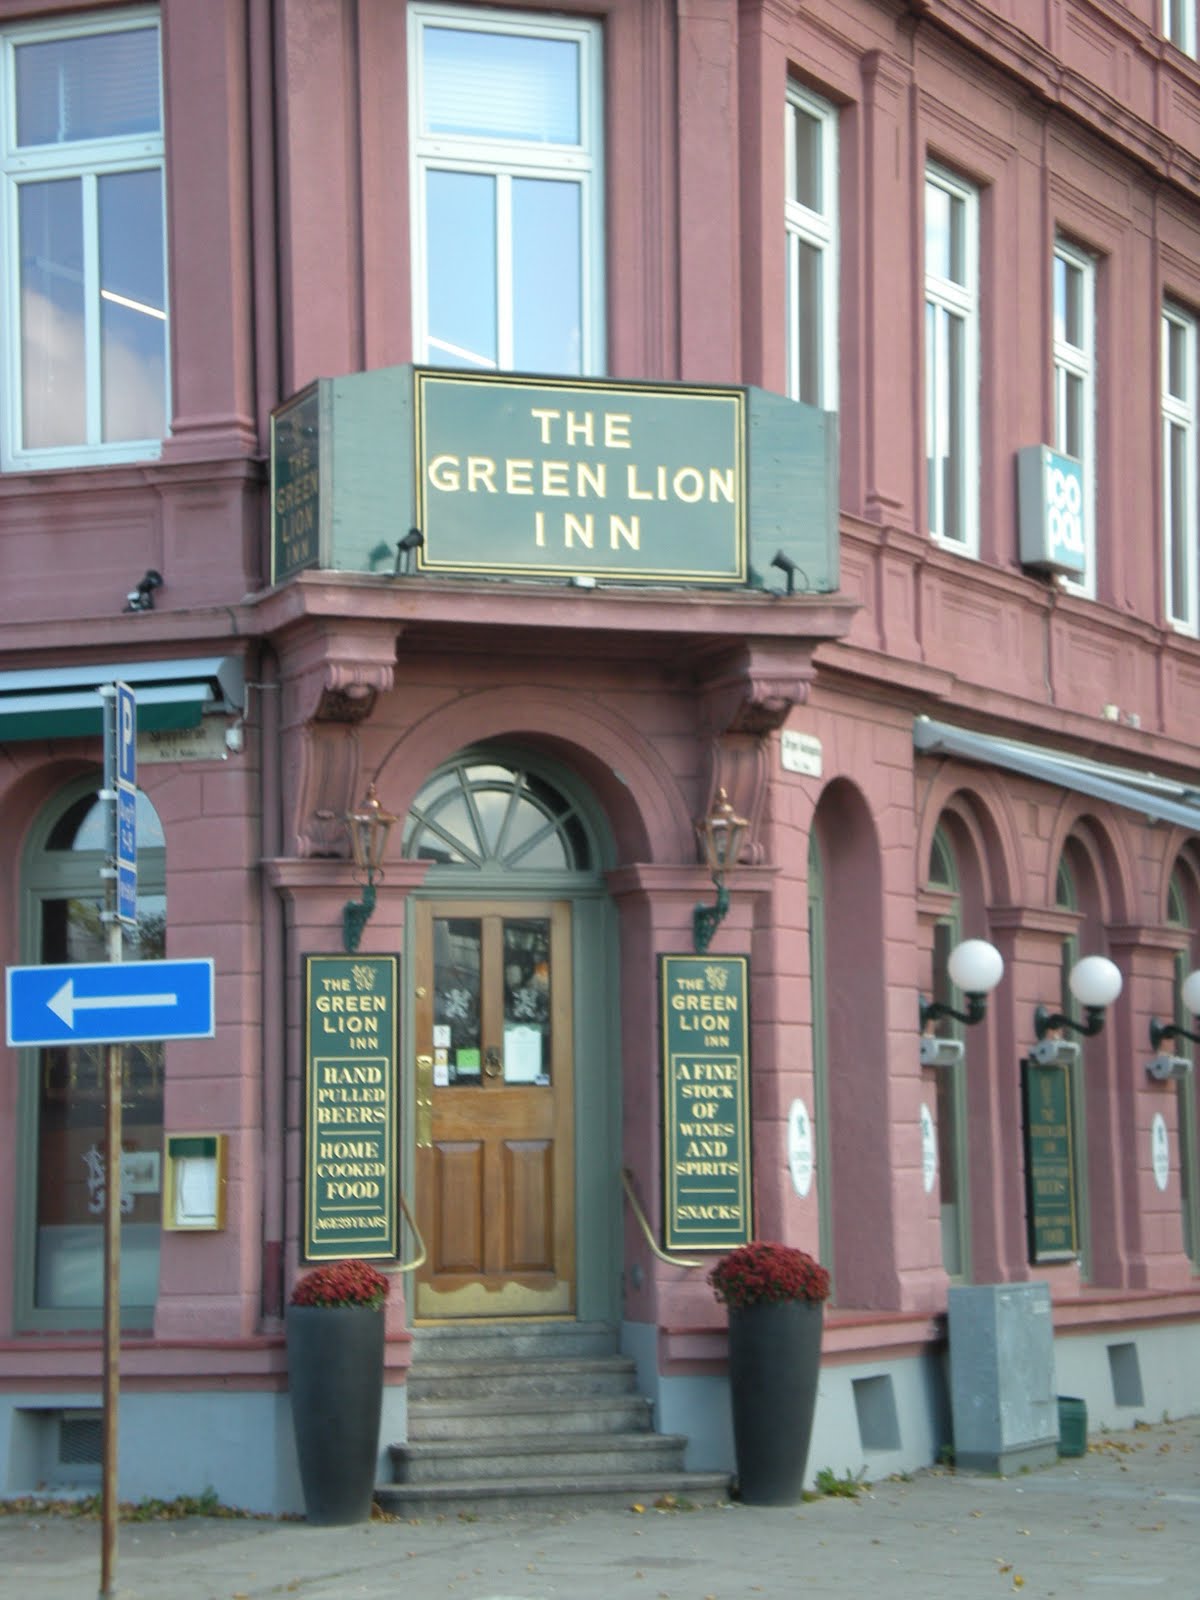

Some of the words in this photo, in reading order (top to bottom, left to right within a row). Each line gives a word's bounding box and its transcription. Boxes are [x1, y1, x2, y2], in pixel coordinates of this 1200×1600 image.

[532, 407, 632, 449] THE
[428, 455, 606, 498] GREEN
[627, 465, 735, 503] LION
[282, 505, 312, 543] LION
[535, 512, 641, 550] INN
[122, 696, 133, 774] P
[322, 978, 350, 991] THE
[677, 978, 704, 991] THE
[316, 996, 386, 1013] GREEN
[672, 995, 737, 1011] GREEN
[323, 1016, 378, 1033] LION
[680, 1015, 730, 1031] LION
[350, 1037, 378, 1049] INN
[704, 1036, 729, 1047] INN
[324, 1067, 382, 1084] HAND
[676, 1064, 691, 1080] A
[694, 1064, 738, 1080] FINE
[318, 1089, 385, 1102] PULLED
[682, 1085, 734, 1098] STOCK
[318, 1107, 385, 1123] BEERS
[692, 1103, 719, 1119] OF
[680, 1123, 735, 1137] WINES
[320, 1142, 379, 1159] HOME
[686, 1141, 728, 1157] AND
[317, 1163, 386, 1177] COOKED
[675, 1162, 739, 1176] SPIRITS
[327, 1181, 379, 1200] FOOD
[677, 1205, 741, 1219] SNACKS
